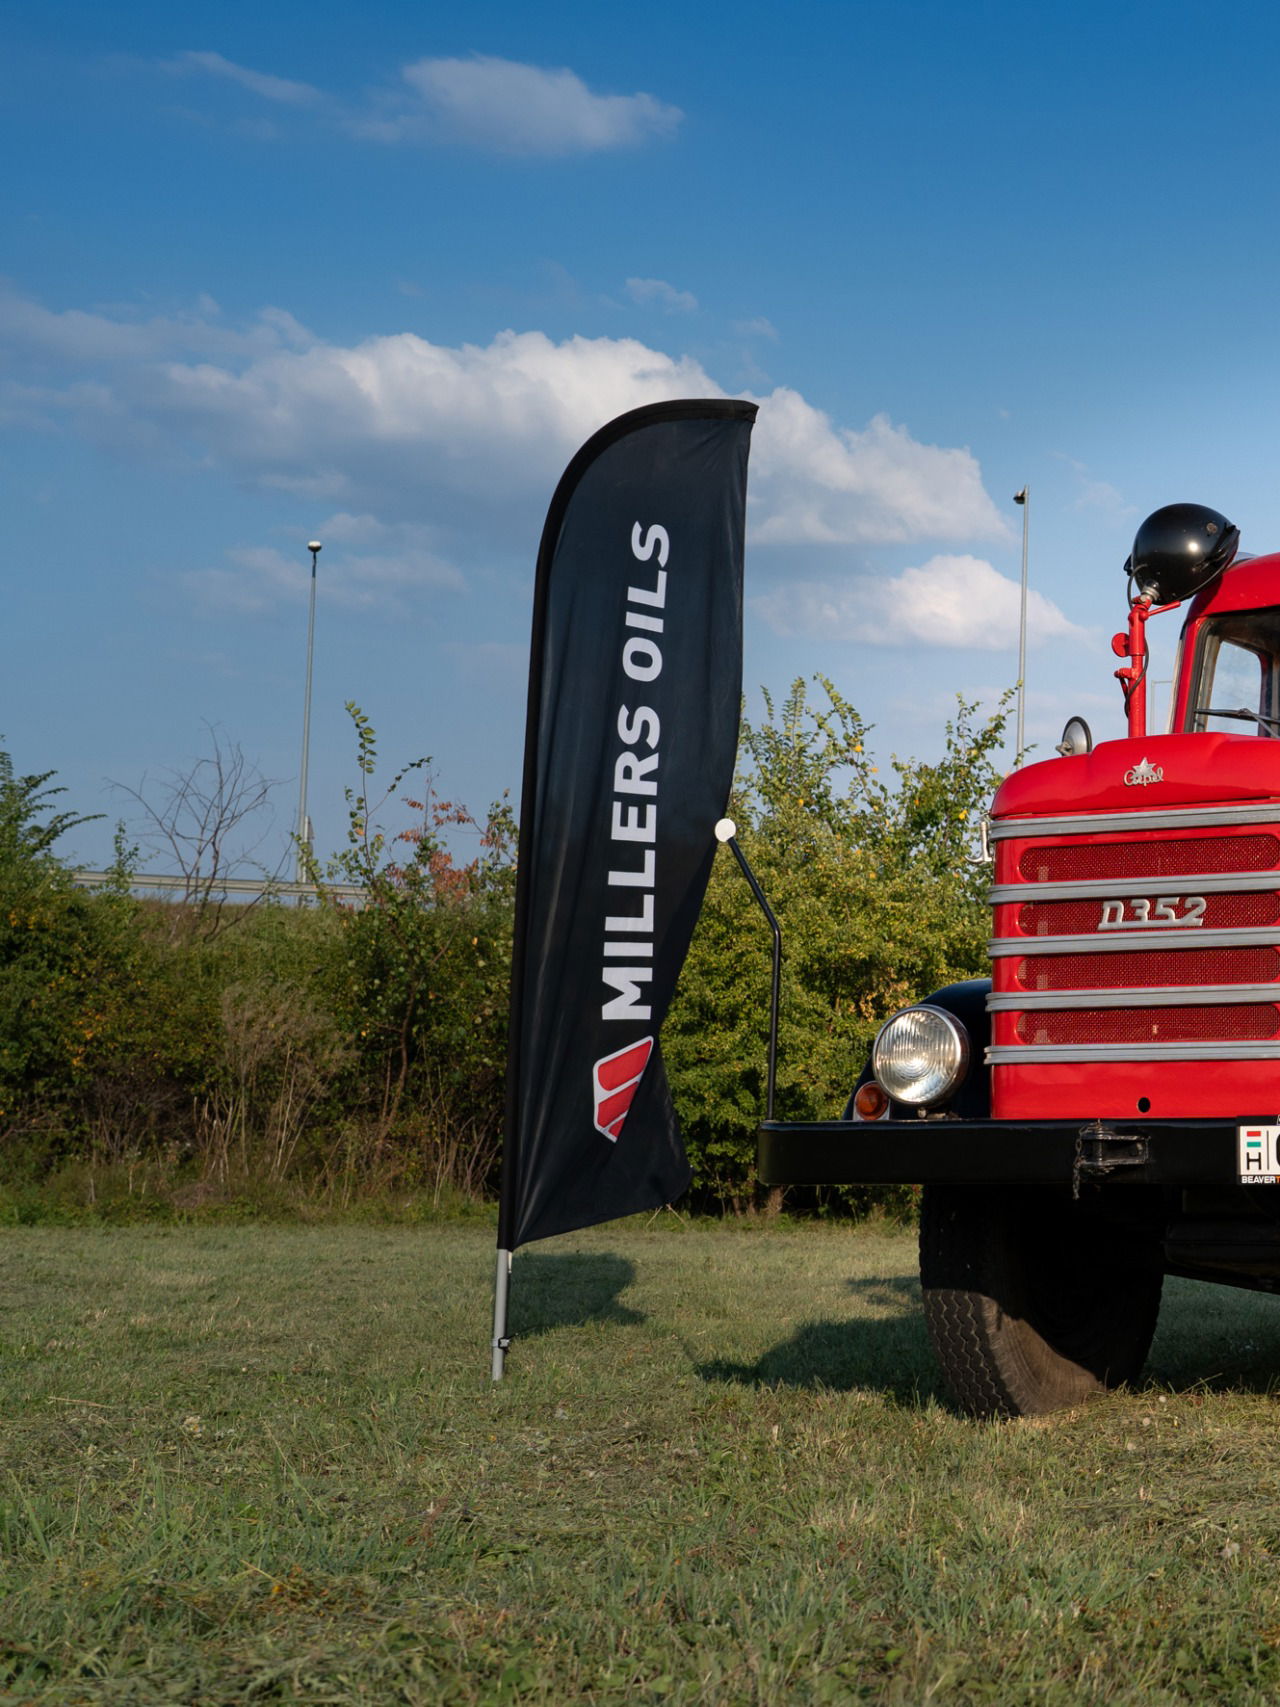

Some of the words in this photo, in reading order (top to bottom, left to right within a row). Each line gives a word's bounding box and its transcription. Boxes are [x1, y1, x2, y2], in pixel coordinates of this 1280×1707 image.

[622, 521, 670, 682] OILS
[602, 704, 661, 1020] MILLERS
[1098, 896, 1207, 930] D352
[1246, 1152, 1262, 1170] H
